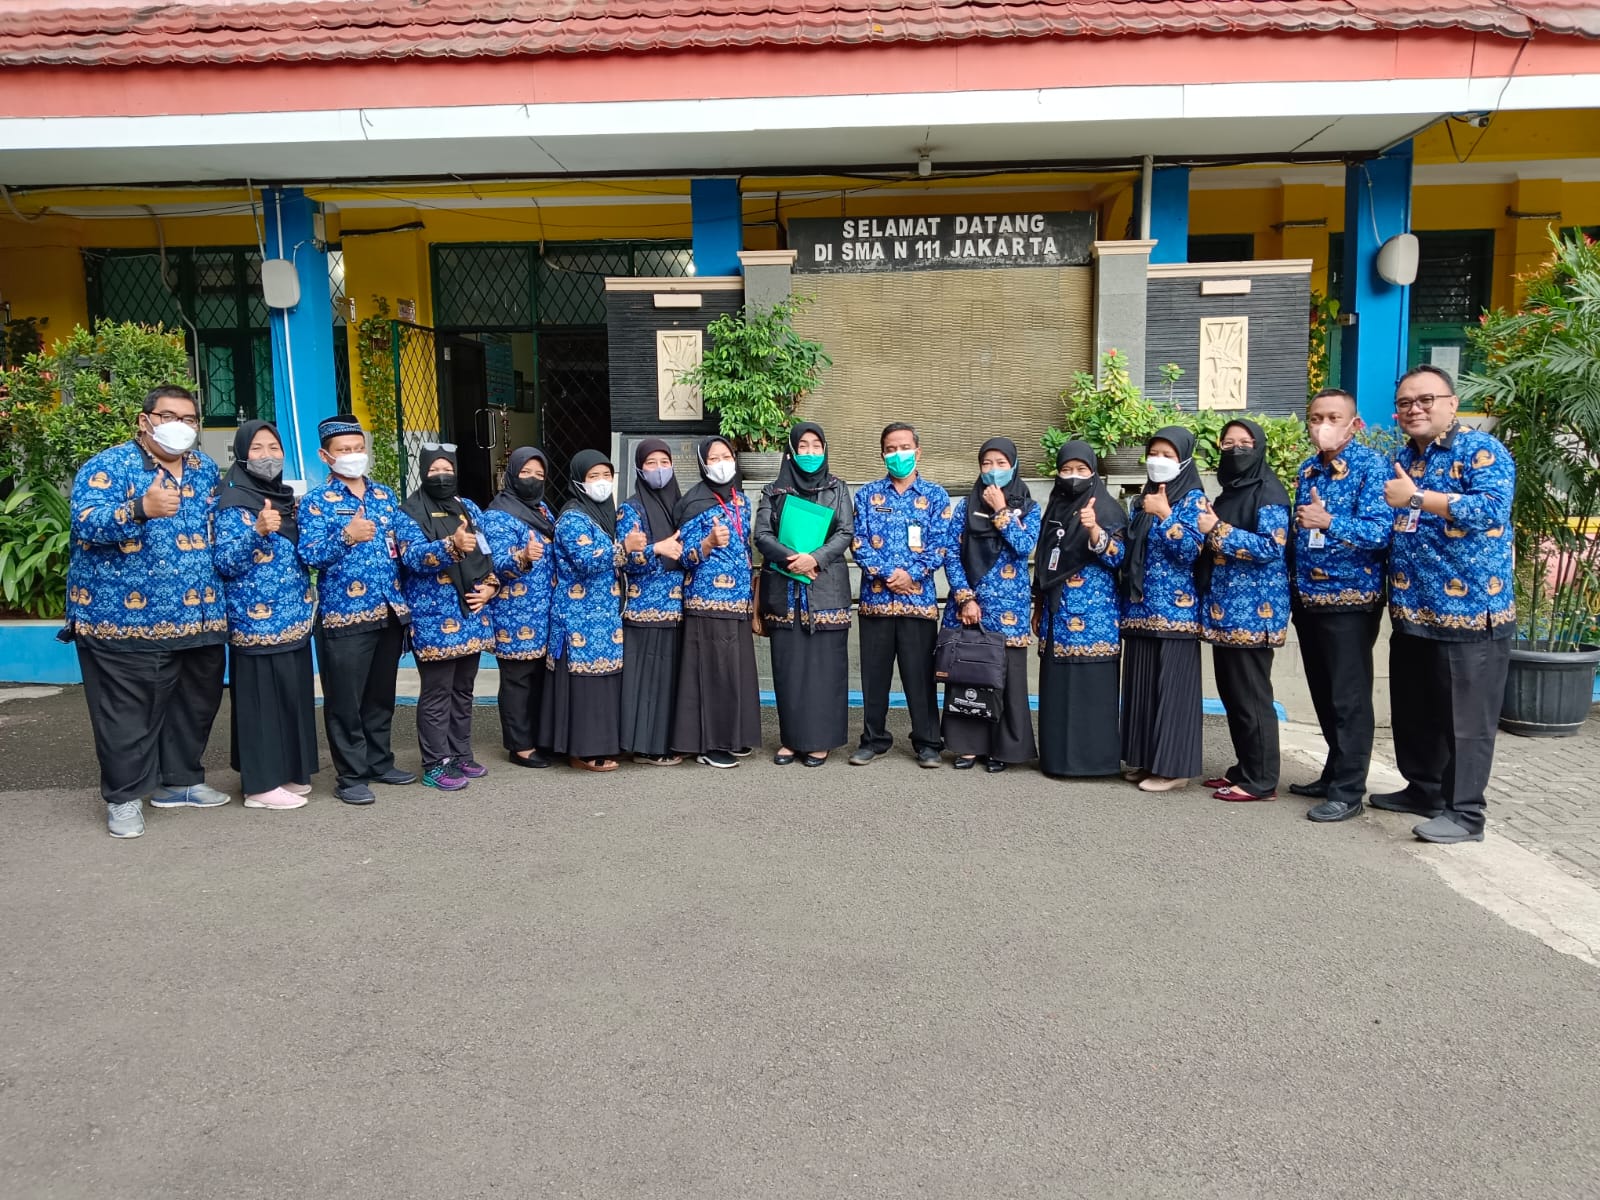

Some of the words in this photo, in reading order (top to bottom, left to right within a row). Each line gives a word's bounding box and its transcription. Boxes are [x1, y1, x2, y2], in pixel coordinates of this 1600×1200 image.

[842, 217, 941, 239] SELAMAT
[955, 214, 1045, 235] DATANG
[814, 243, 833, 261] DI
[841, 241, 885, 261] SMA
[894, 240, 908, 260] N
[915, 239, 941, 259] 111
[950, 236, 1058, 258] JAKARTA
